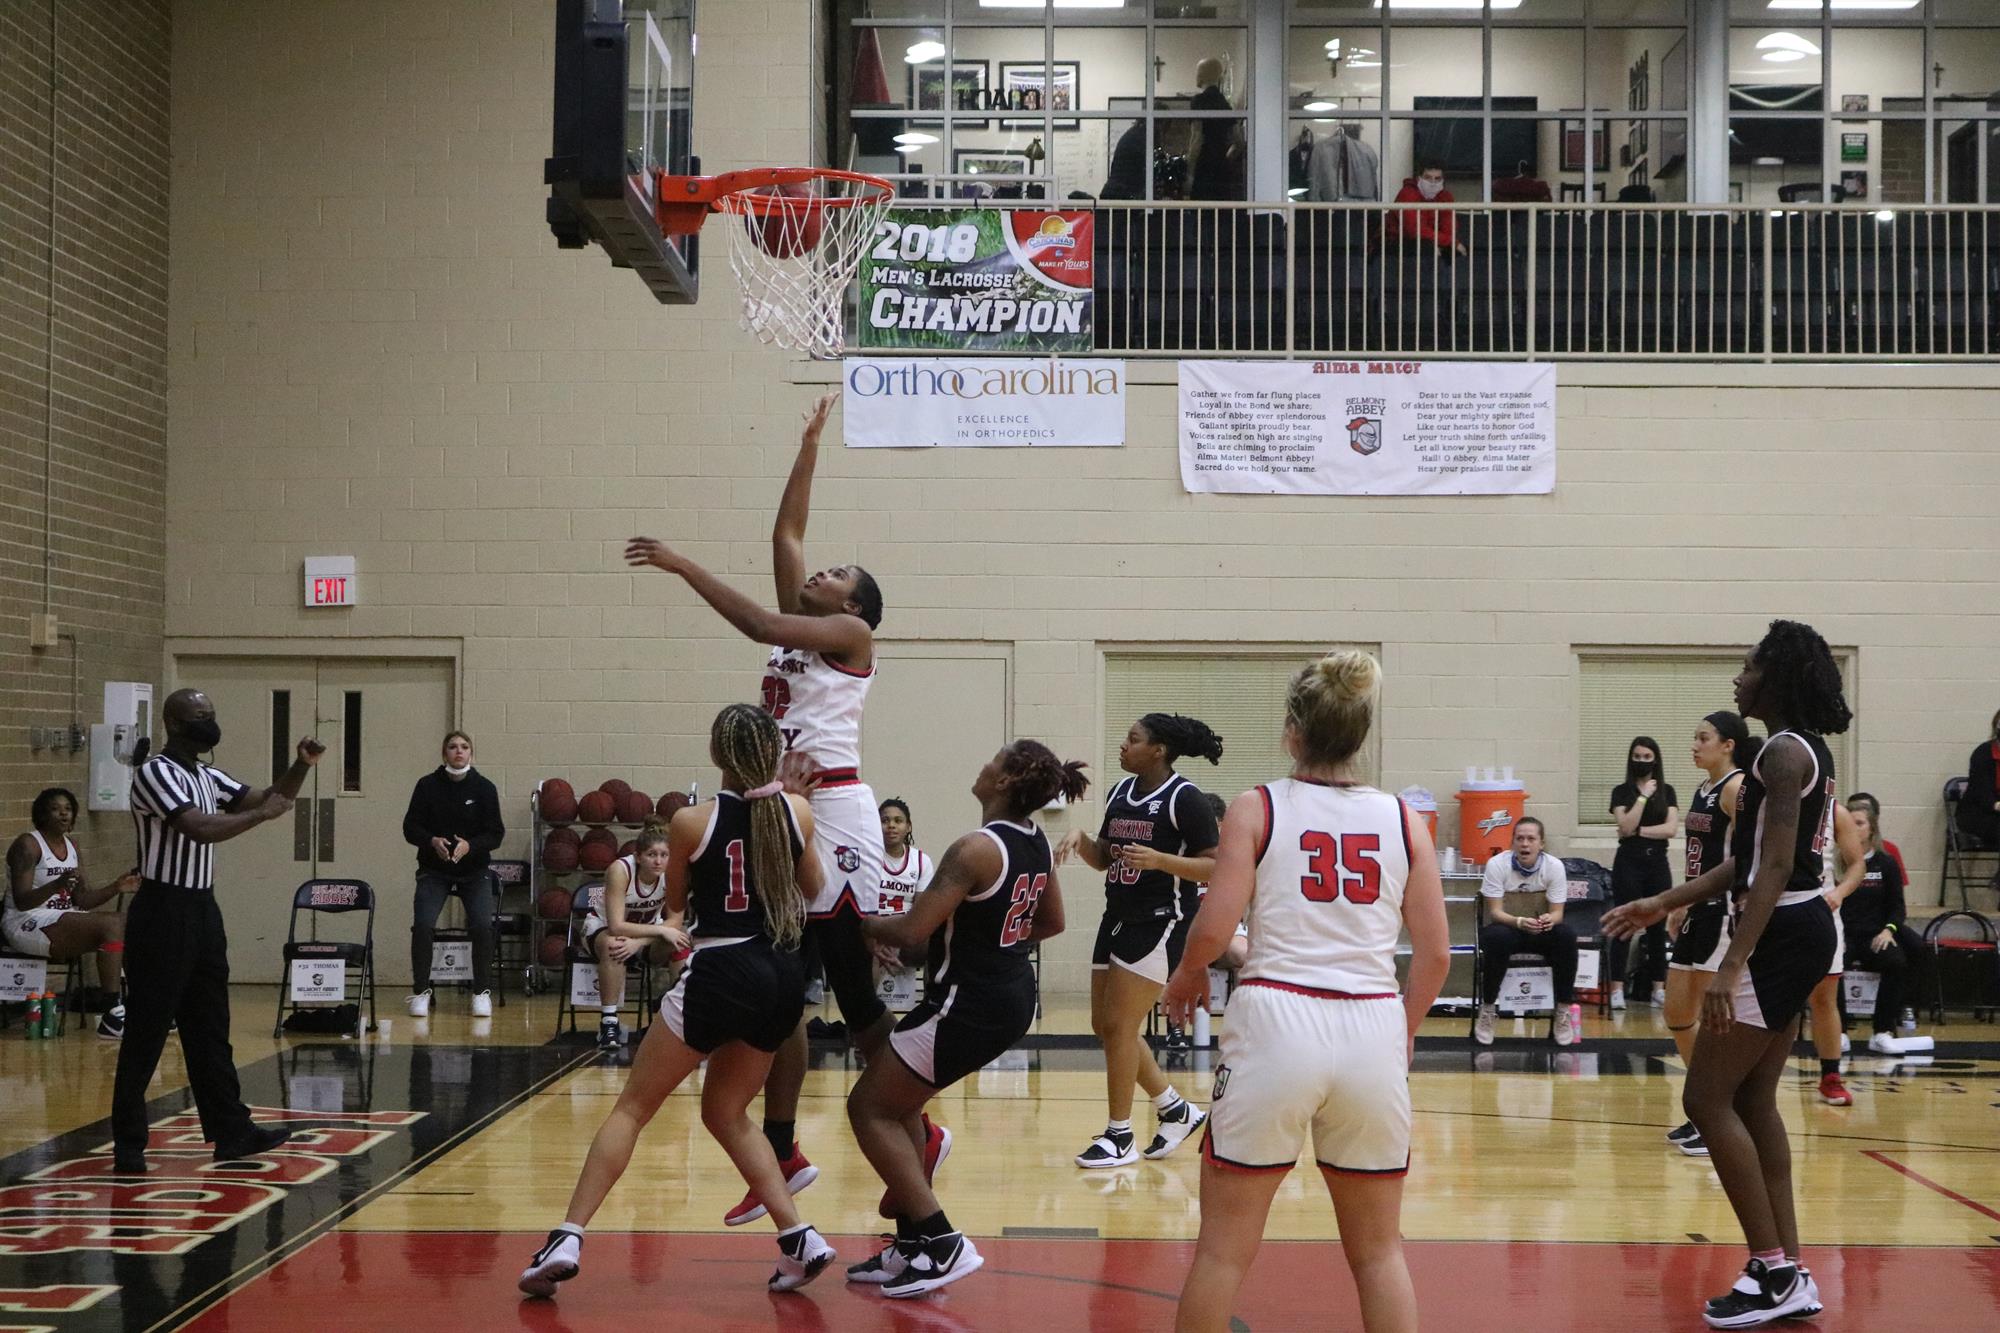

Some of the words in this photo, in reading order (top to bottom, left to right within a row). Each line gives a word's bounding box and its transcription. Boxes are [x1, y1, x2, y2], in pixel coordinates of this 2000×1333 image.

[871, 222, 979, 263] 2018
[871, 266, 924, 286] MEN'S
[928, 270, 1014, 288] LACROSSE
[869, 289, 1084, 333] CHAMPION
[1312, 362, 1360, 374] Alma
[1367, 362, 1422, 374] Mater
[850, 362, 1119, 399] OrthoCarolina
[1235, 391, 1254, 399] from
[1271, 392, 1292, 401] flung
[1296, 392, 1321, 401] places
[1480, 391, 1496, 399] Vast
[1499, 392, 1532, 400] expanse
[1200, 401, 1221, 410] Loyal
[1346, 397, 1386, 405] BELMONT
[1346, 405, 1386, 416] ABBEY
[1476, 403, 1496, 411] your
[1498, 402, 1530, 410] crimson
[957, 415, 1030, 424] EXCELLENCE
[1186, 411, 1215, 419] Friends
[1229, 412, 1253, 421] Abbey
[1277, 413, 1326, 421] splendorous
[1439, 414, 1458, 422] your
[1461, 413, 1489, 421] mighty
[1492, 412, 1511, 421] spire
[1231, 423, 1255, 432] spirits
[1258, 424, 1289, 432] proudly
[1417, 423, 1434, 431] Like
[1453, 423, 1479, 431] hearts
[957, 430, 970, 438] IN
[975, 429, 1056, 438] ORTHOPEDICS
[1189, 432, 1215, 440] Voices
[1257, 433, 1275, 443] high
[1293, 434, 1322, 443] singing
[1418, 435, 1437, 443] your
[1440, 433, 1461, 441] truth
[1197, 442, 1215, 450] Bells
[1234, 444, 1265, 453] chiming
[1279, 444, 1314, 453] proclaim
[1443, 444, 1465, 452] know
[1467, 445, 1486, 453] your
[1488, 444, 1516, 452] beauty
[1250, 454, 1282, 462] Belmont
[1507, 454, 1530, 462] Mater
[1195, 463, 1222, 471] Sacred
[1252, 464, 1269, 472] hold
[1271, 466, 1290, 474] your
[1418, 465, 1437, 473] Hear
[1439, 466, 1458, 474] your
[1460, 466, 1489, 474] praises
[1492, 464, 1504, 472] fill
[315, 578, 346, 603] EXIT
[1300, 830, 1381, 904] 35
[725, 839, 749, 912] 1
[880, 880, 914, 893] LMONT
